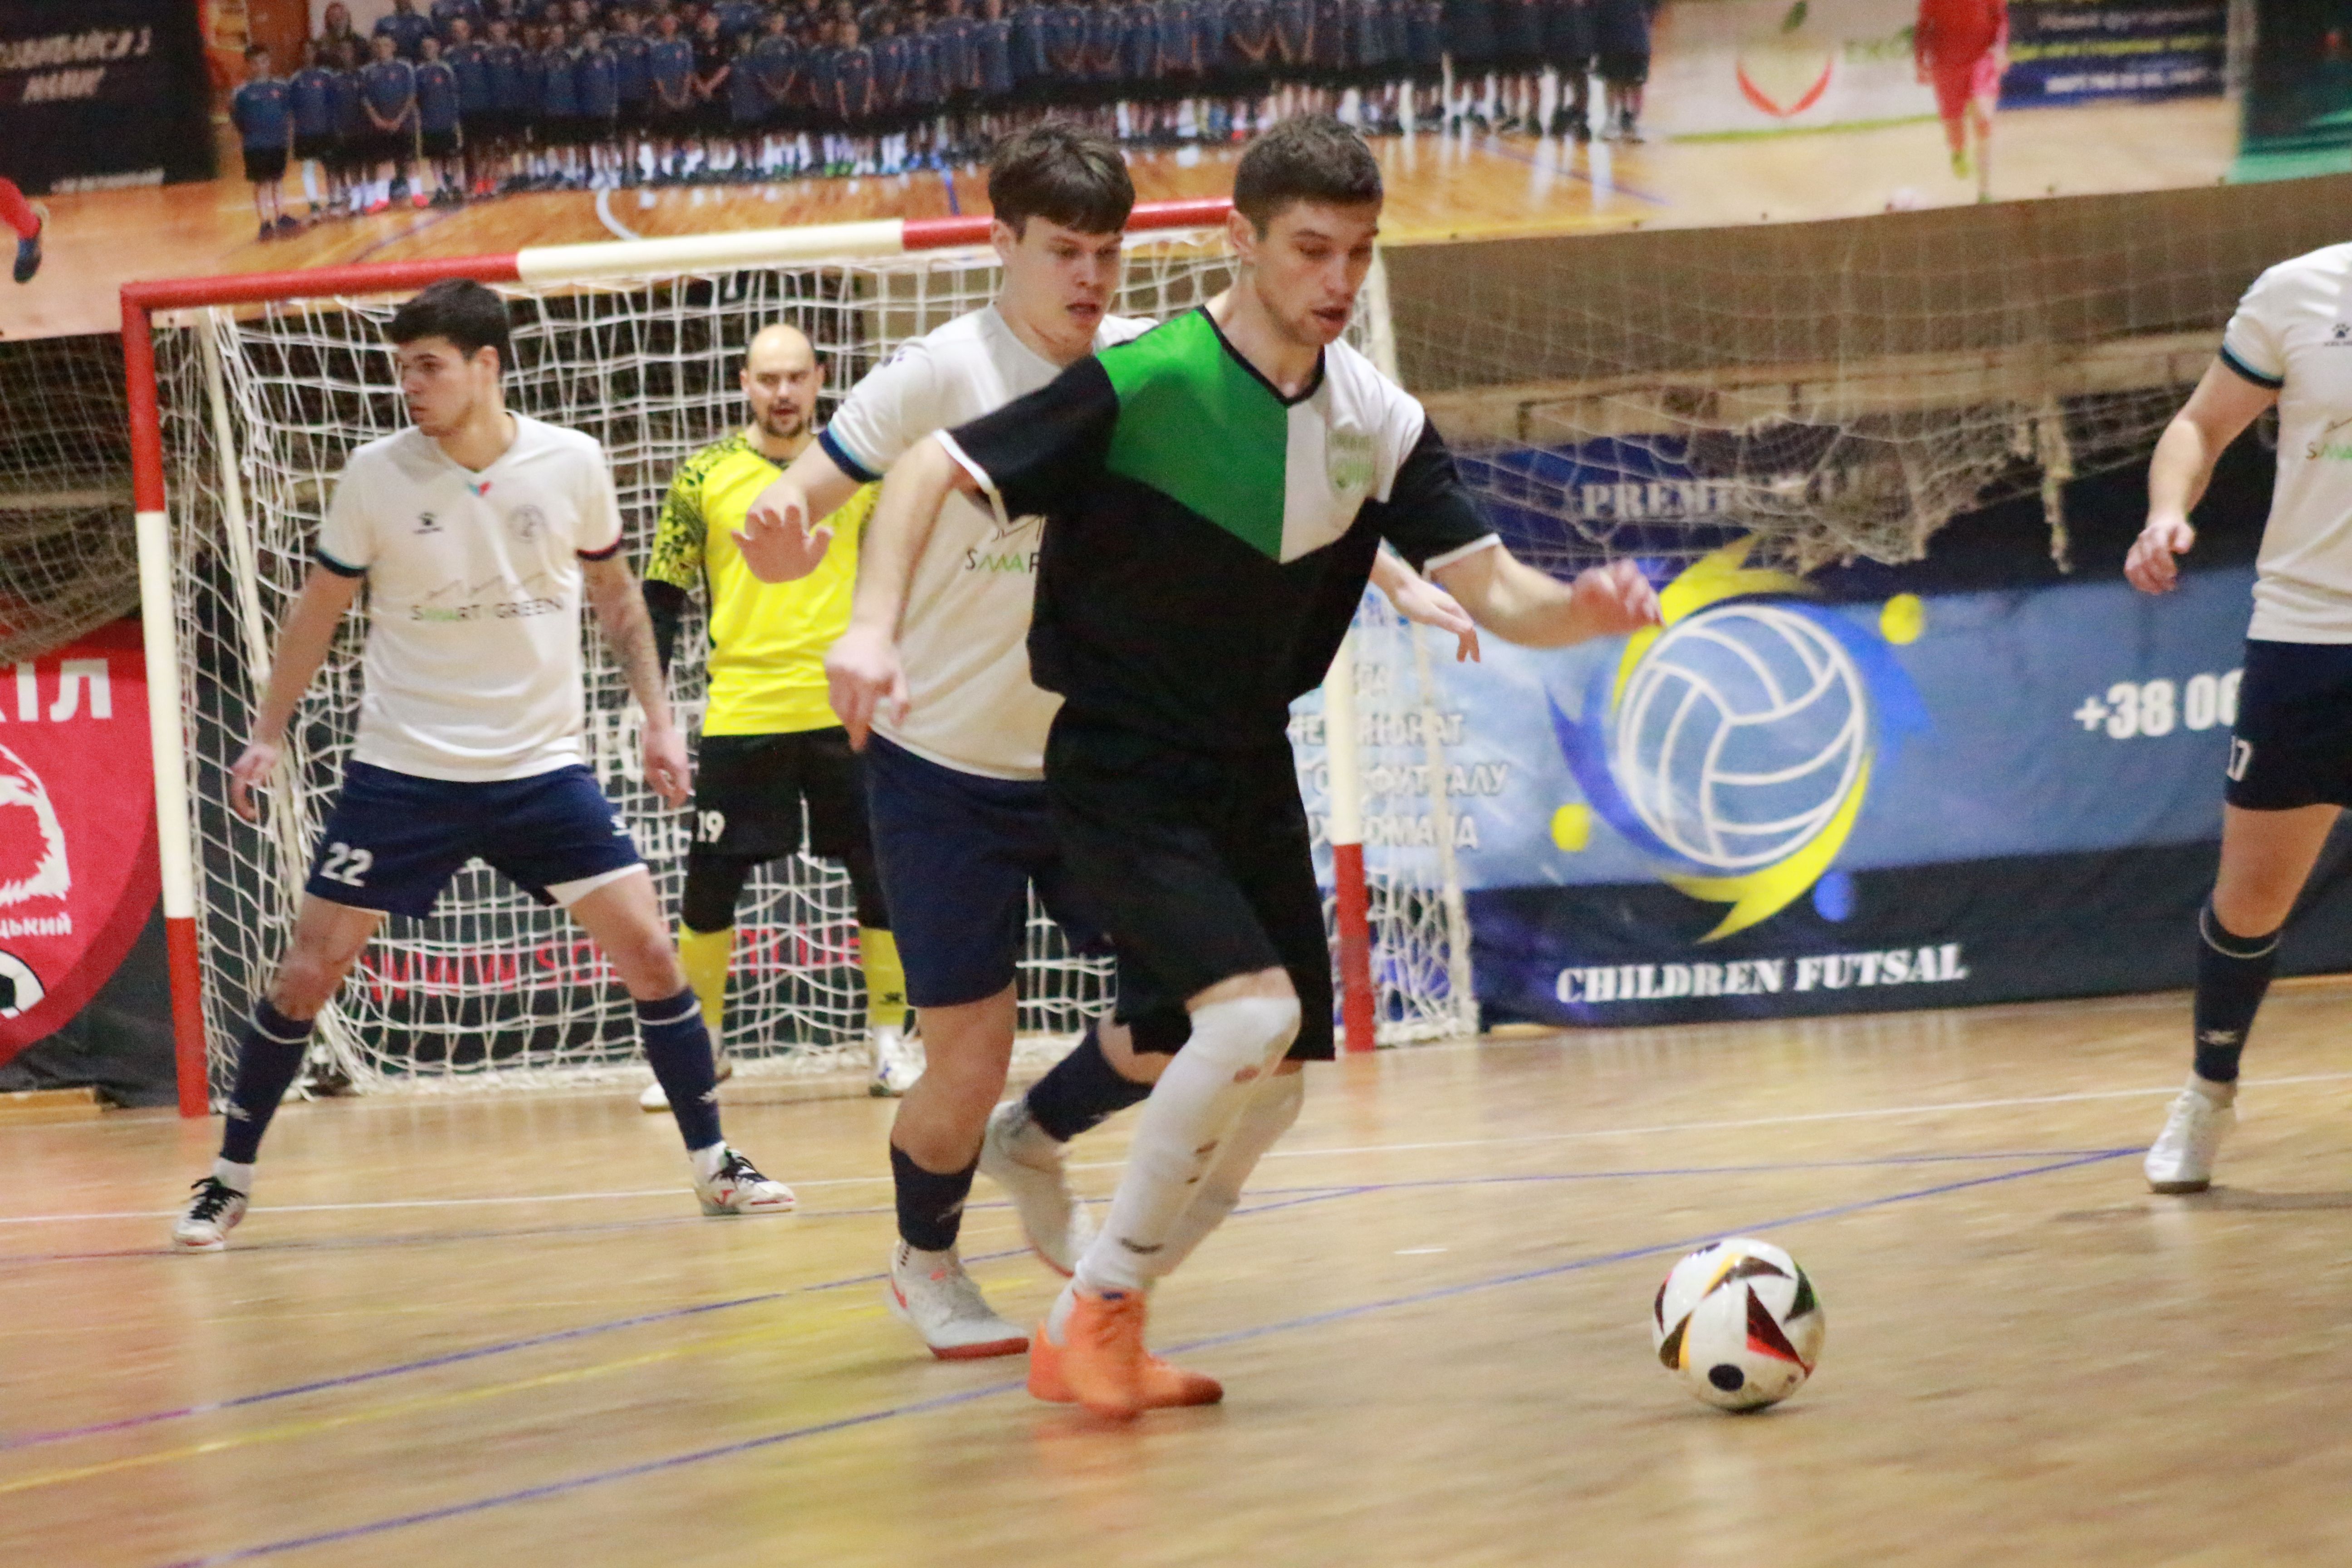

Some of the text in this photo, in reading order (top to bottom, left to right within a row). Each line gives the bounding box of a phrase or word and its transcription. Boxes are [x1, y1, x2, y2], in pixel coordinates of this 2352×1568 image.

[494, 598, 564, 619] GREEN
[0, 658, 113, 722] ІЛ
[2073, 678, 2176, 740] +38
[696, 810, 725, 843] 19
[319, 841, 373, 887] 22
[1556, 942, 1970, 1003] CHILDREN FUTSAL
